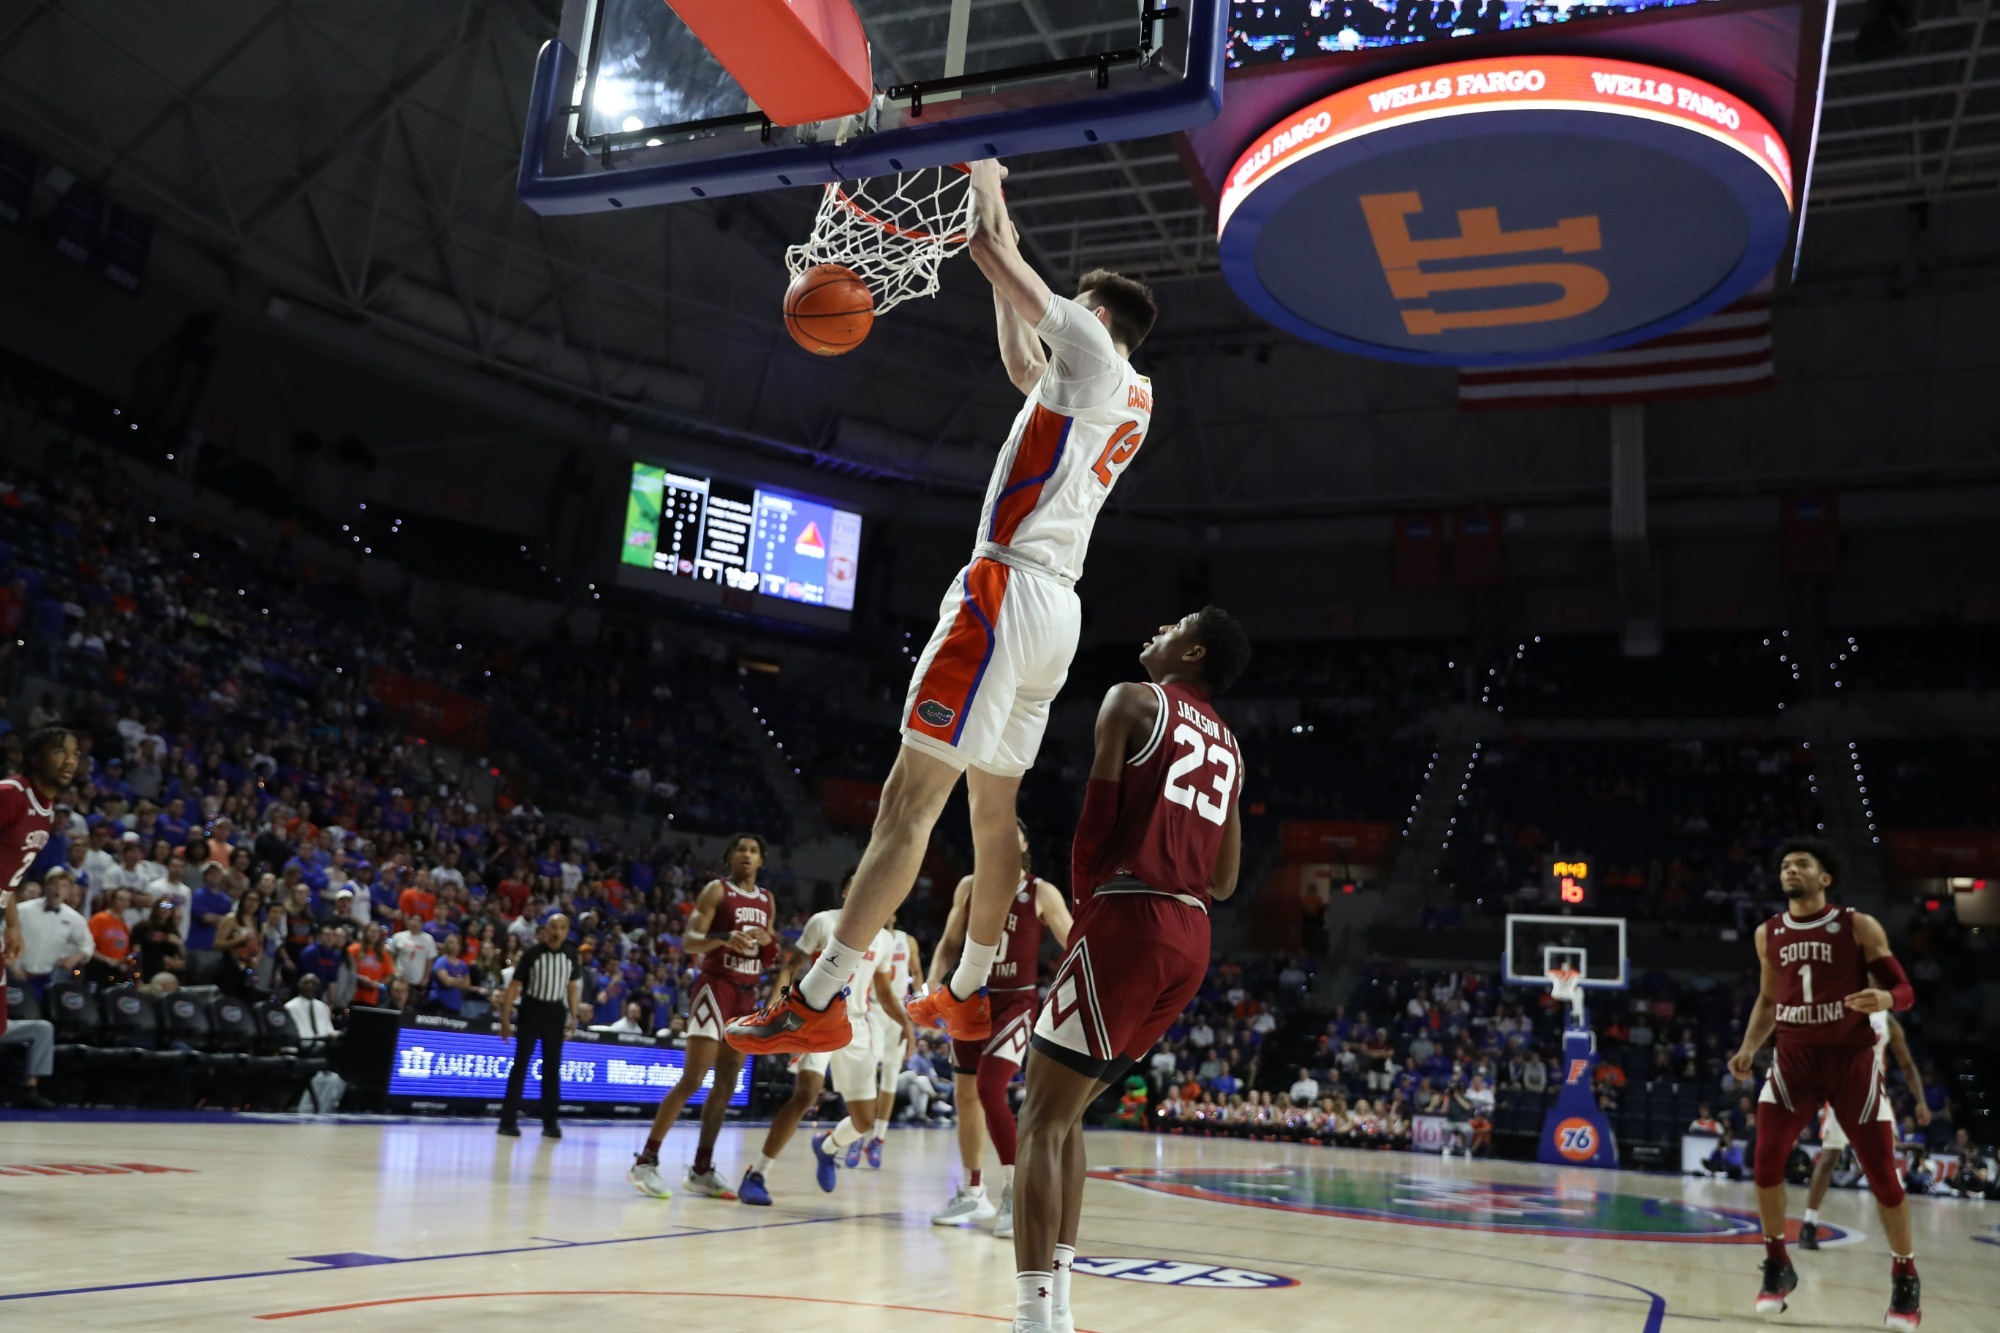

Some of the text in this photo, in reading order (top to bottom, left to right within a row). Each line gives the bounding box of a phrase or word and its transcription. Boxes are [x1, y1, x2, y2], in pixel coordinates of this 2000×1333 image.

[1368, 70, 1545, 113] WELLS FARGO
[1591, 72, 1740, 130] WELLS FARGO
[1272, 112, 1331, 157] FARGO
[1359, 191, 1609, 334] UF
[1178, 700, 1232, 748] JACKSON II
[1164, 723, 1236, 826] 23
[735, 907, 767, 927] SOUTH
[723, 953, 760, 975] CAROLI
[1779, 941, 1832, 967] SOUTH
[1798, 964, 1813, 1003] 1
[1775, 1001, 1844, 1024] CAROLINA
[432, 1053, 596, 1083] AMERIC CPUS
[1566, 1059, 1588, 1084] F
[1559, 1126, 1594, 1152] 76
